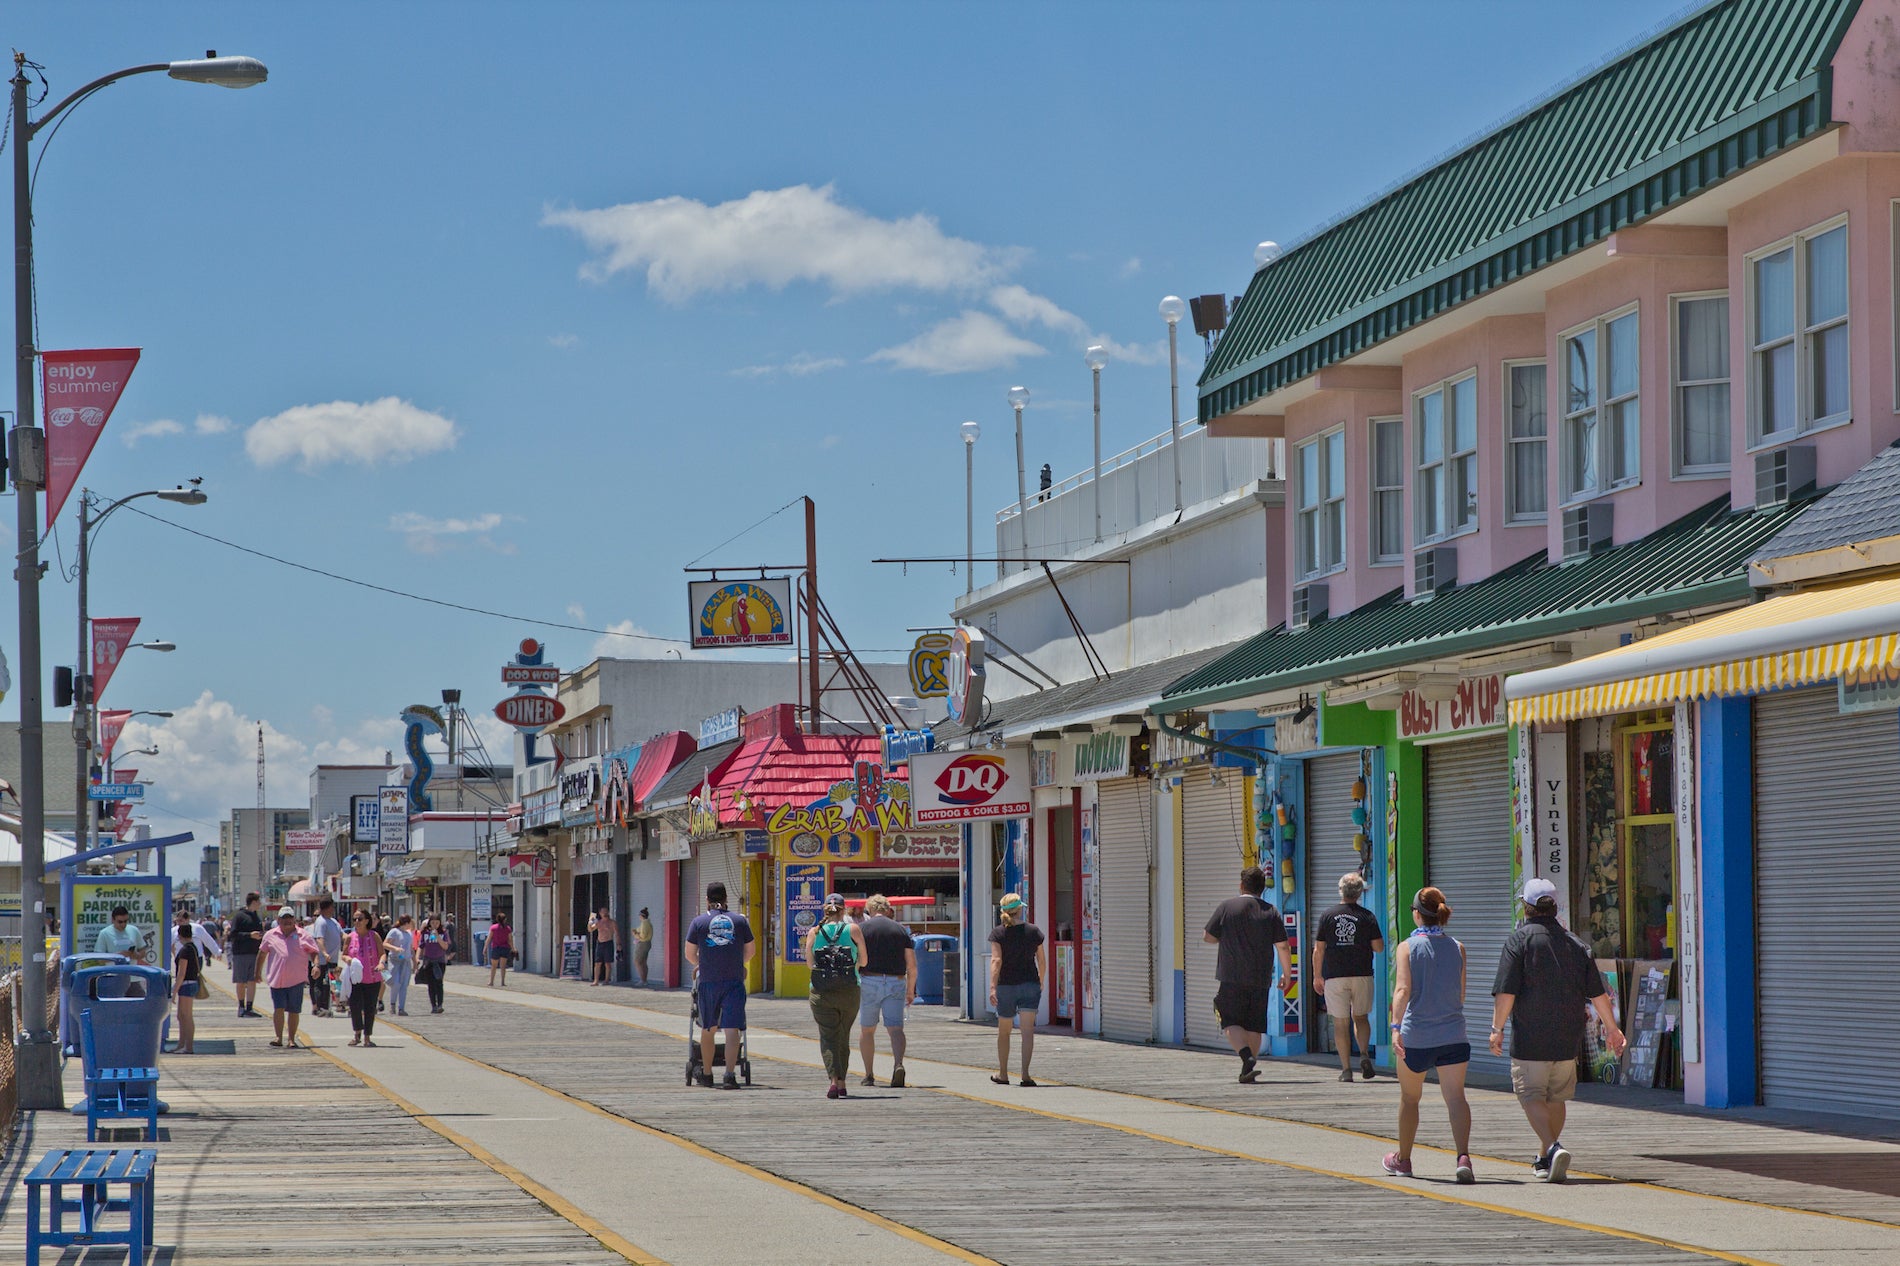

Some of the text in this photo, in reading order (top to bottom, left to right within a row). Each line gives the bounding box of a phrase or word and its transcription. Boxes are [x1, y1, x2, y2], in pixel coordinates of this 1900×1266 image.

[48, 363, 96, 380] enjoy
[48, 380, 118, 393] summer
[702, 589, 730, 629] GRAB
[733, 585, 743, 596] A
[506, 670, 557, 680] DOO WOP
[1478, 674, 1500, 725] UP
[506, 698, 555, 723] DINER
[948, 764, 999, 794] DQ
[1520, 731, 1529, 834] Posters
[92, 786, 140, 795] SPENCER AVE
[359, 803, 378, 815] FUD
[920, 803, 1028, 820] HOTDOG & COKE $3.00
[767, 802, 848, 834] GRAB
[849, 805, 871, 832] A
[1546, 780, 1561, 873] Vintage
[95, 887, 142, 899] Smitty's
[83, 900, 153, 911] PARKING &
[77, 912, 160, 924] BIKE NTAL
[1683, 892, 1694, 1004] Vinyl
